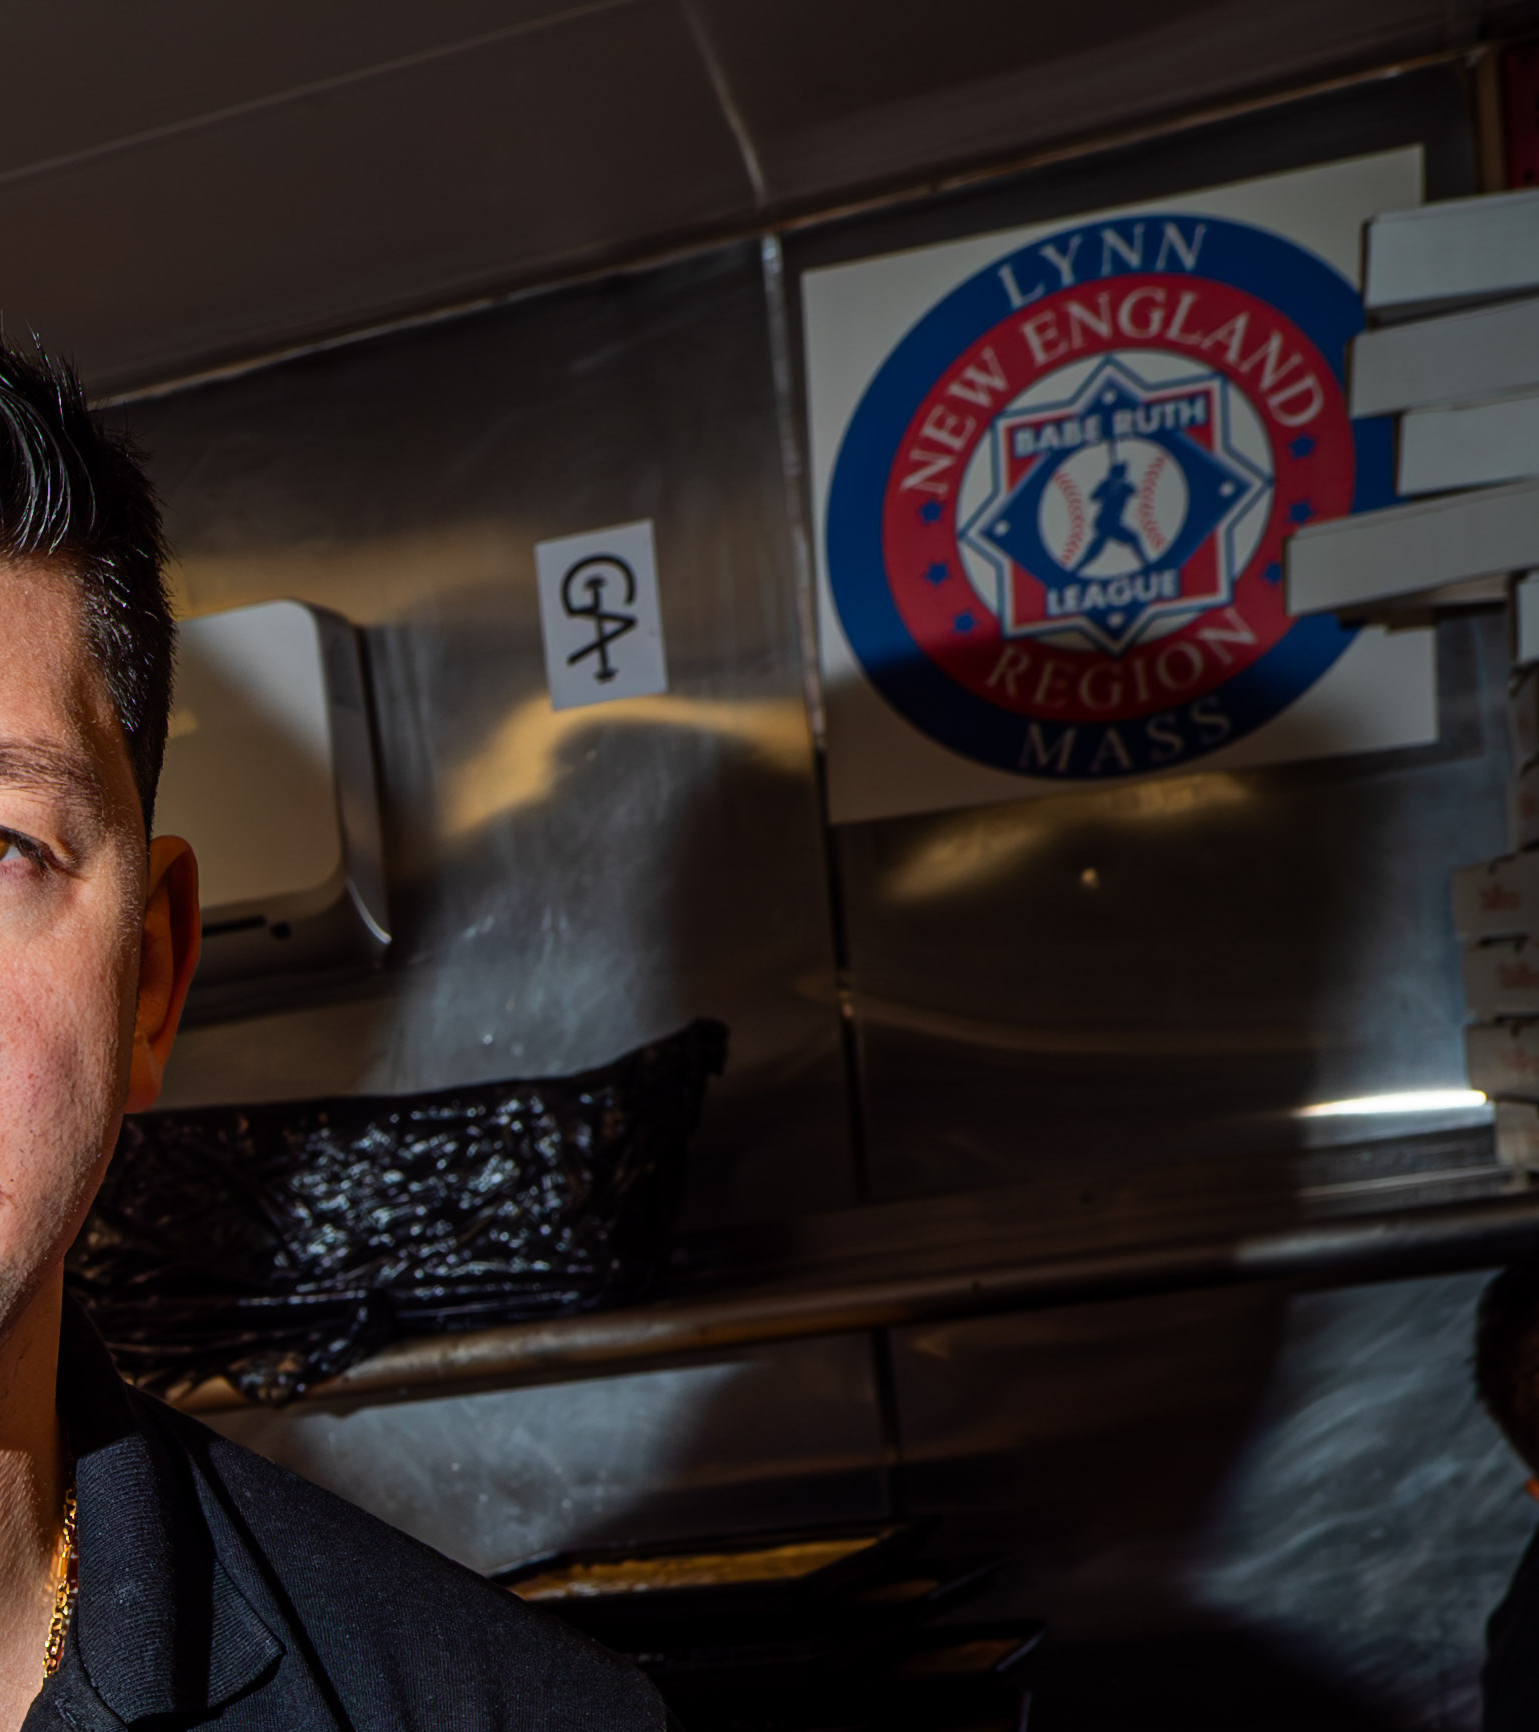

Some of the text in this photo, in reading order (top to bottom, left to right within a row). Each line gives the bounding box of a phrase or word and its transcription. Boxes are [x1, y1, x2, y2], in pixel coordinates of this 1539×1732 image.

[997, 222, 1208, 309] LYNN
[899, 286, 1324, 496] NEW ENGLAND
[1015, 396, 1207, 456] BABE RUTH
[1045, 567, 1183, 616] LEAGUE
[984, 606, 1258, 712] REGION
[1019, 694, 1233, 774] MASS
